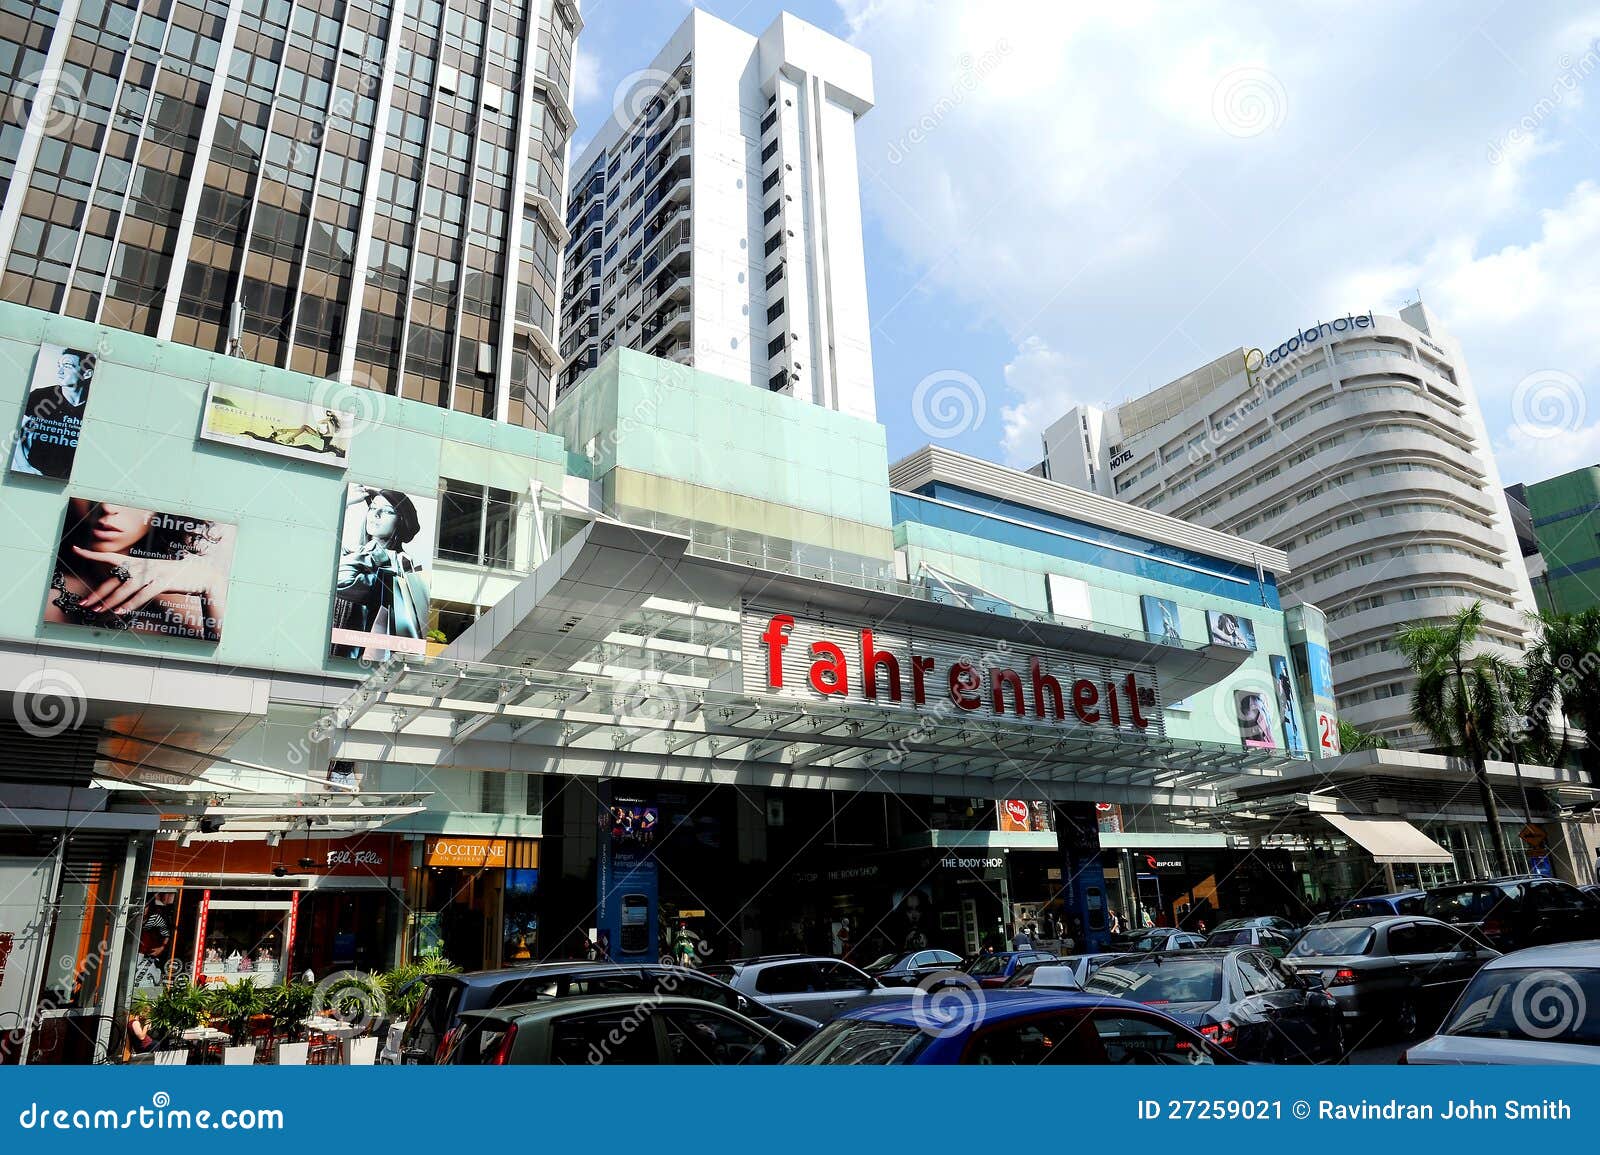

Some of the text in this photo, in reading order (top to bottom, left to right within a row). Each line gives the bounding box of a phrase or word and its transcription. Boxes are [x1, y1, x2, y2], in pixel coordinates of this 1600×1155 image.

[1110, 450, 1134, 471] HOTEL
[762, 614, 1148, 729] fahrenheit
[426, 842, 505, 857] L'OCCITANE
[940, 858, 958, 868] THE
[958, 858, 981, 868] BODY
